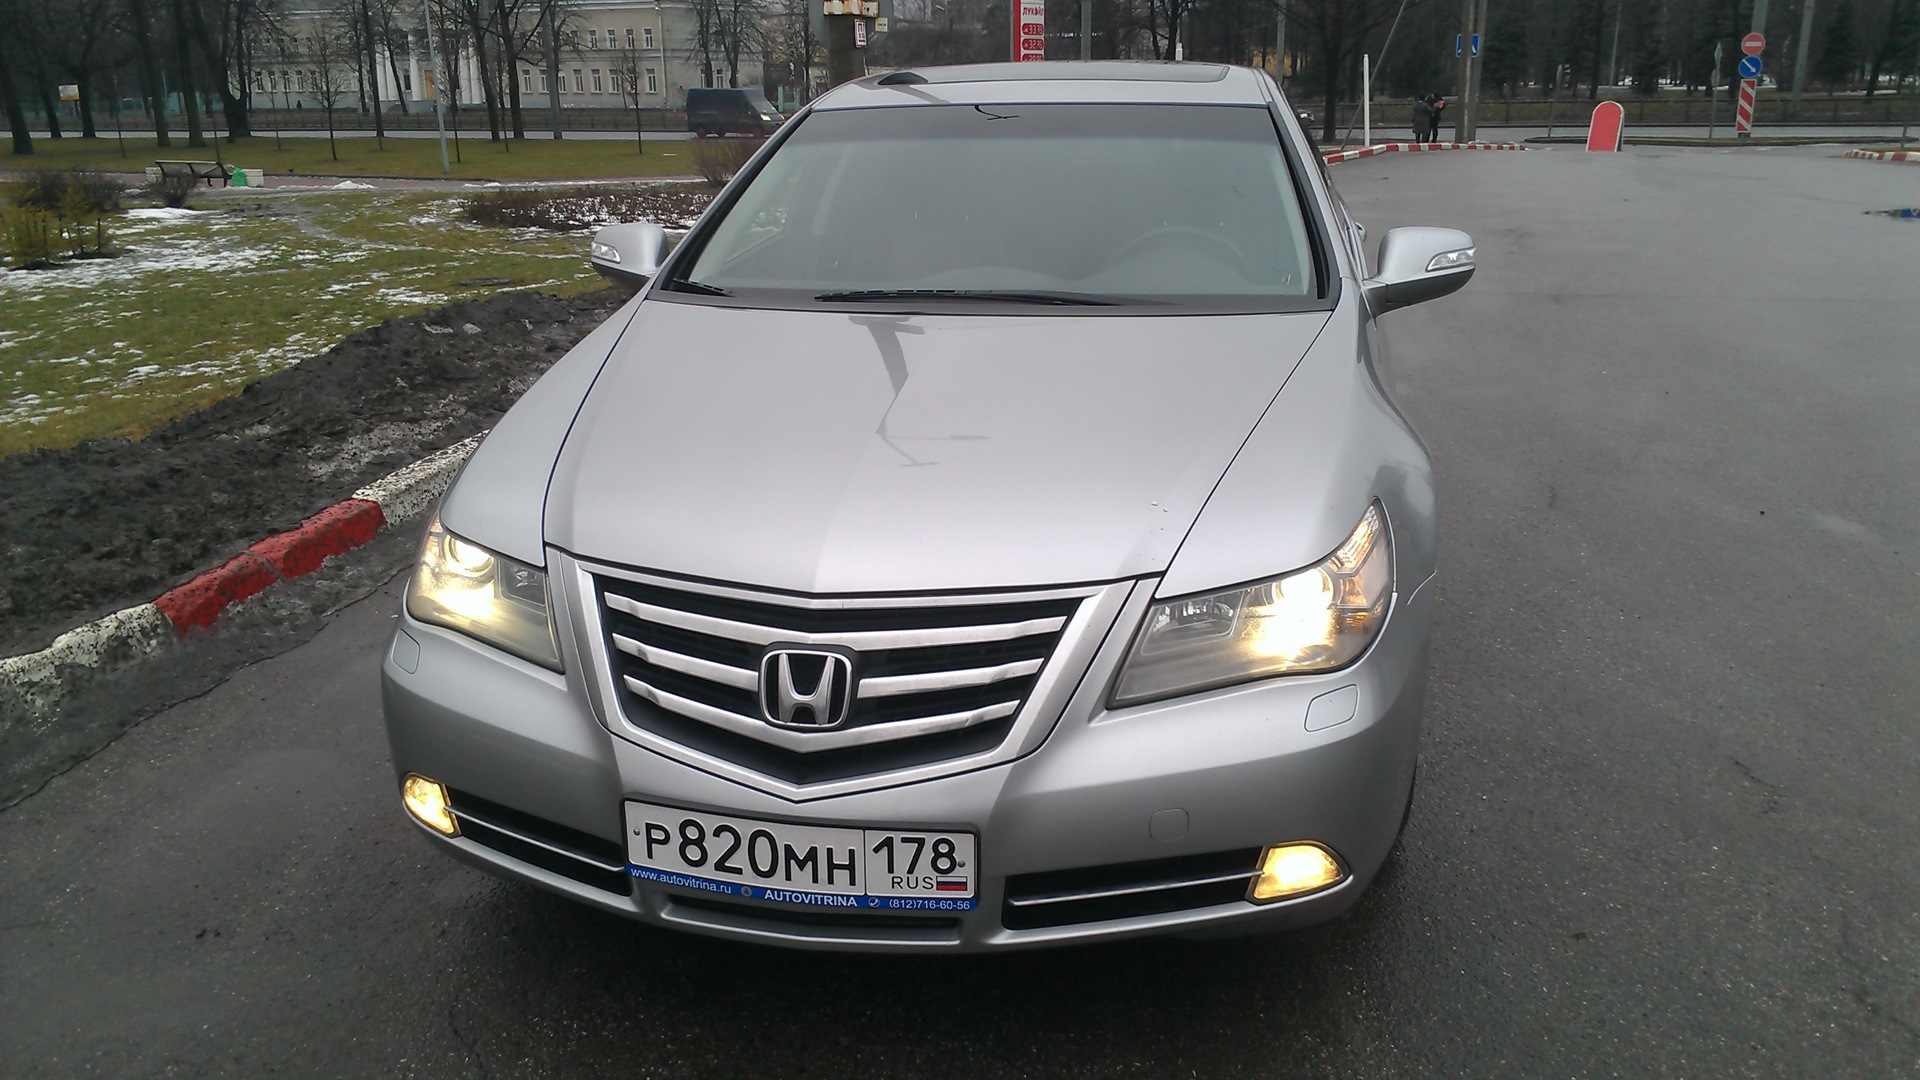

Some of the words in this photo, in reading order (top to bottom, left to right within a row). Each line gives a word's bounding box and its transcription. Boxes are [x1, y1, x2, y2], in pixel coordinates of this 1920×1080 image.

[872, 836, 957, 875] 178
[630, 868, 732, 894] www.autovitrina.ru
[764, 889, 858, 908] AUTOVITRINA
[889, 899, 970, 911] (812)716-60-56
[891, 876, 934, 890] RUS
